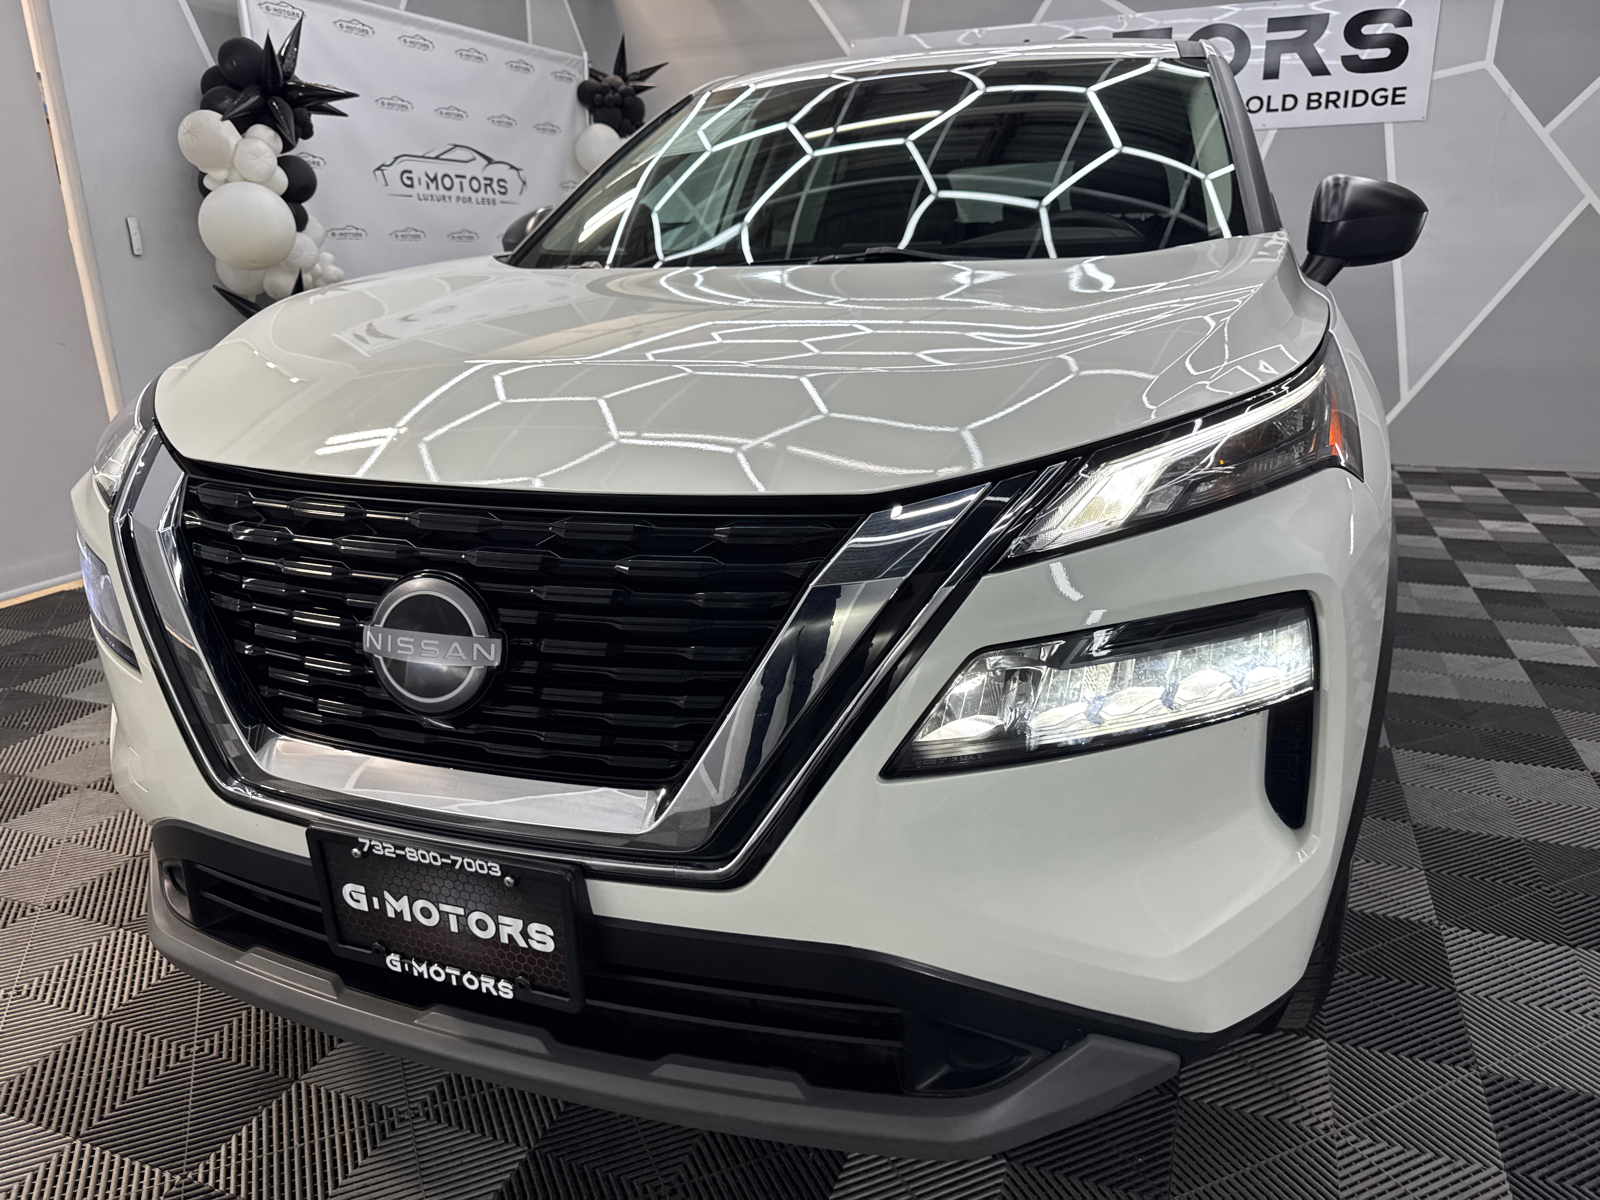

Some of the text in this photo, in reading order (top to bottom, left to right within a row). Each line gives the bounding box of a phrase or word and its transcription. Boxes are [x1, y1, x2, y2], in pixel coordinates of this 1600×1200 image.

[1246, 86, 1407, 114] OLD BRIDGE
[417, 193, 497, 206] LUXURY FOR LESS
[366, 630, 496, 661] NISSAN
[358, 837, 502, 877] 732-800-7003
